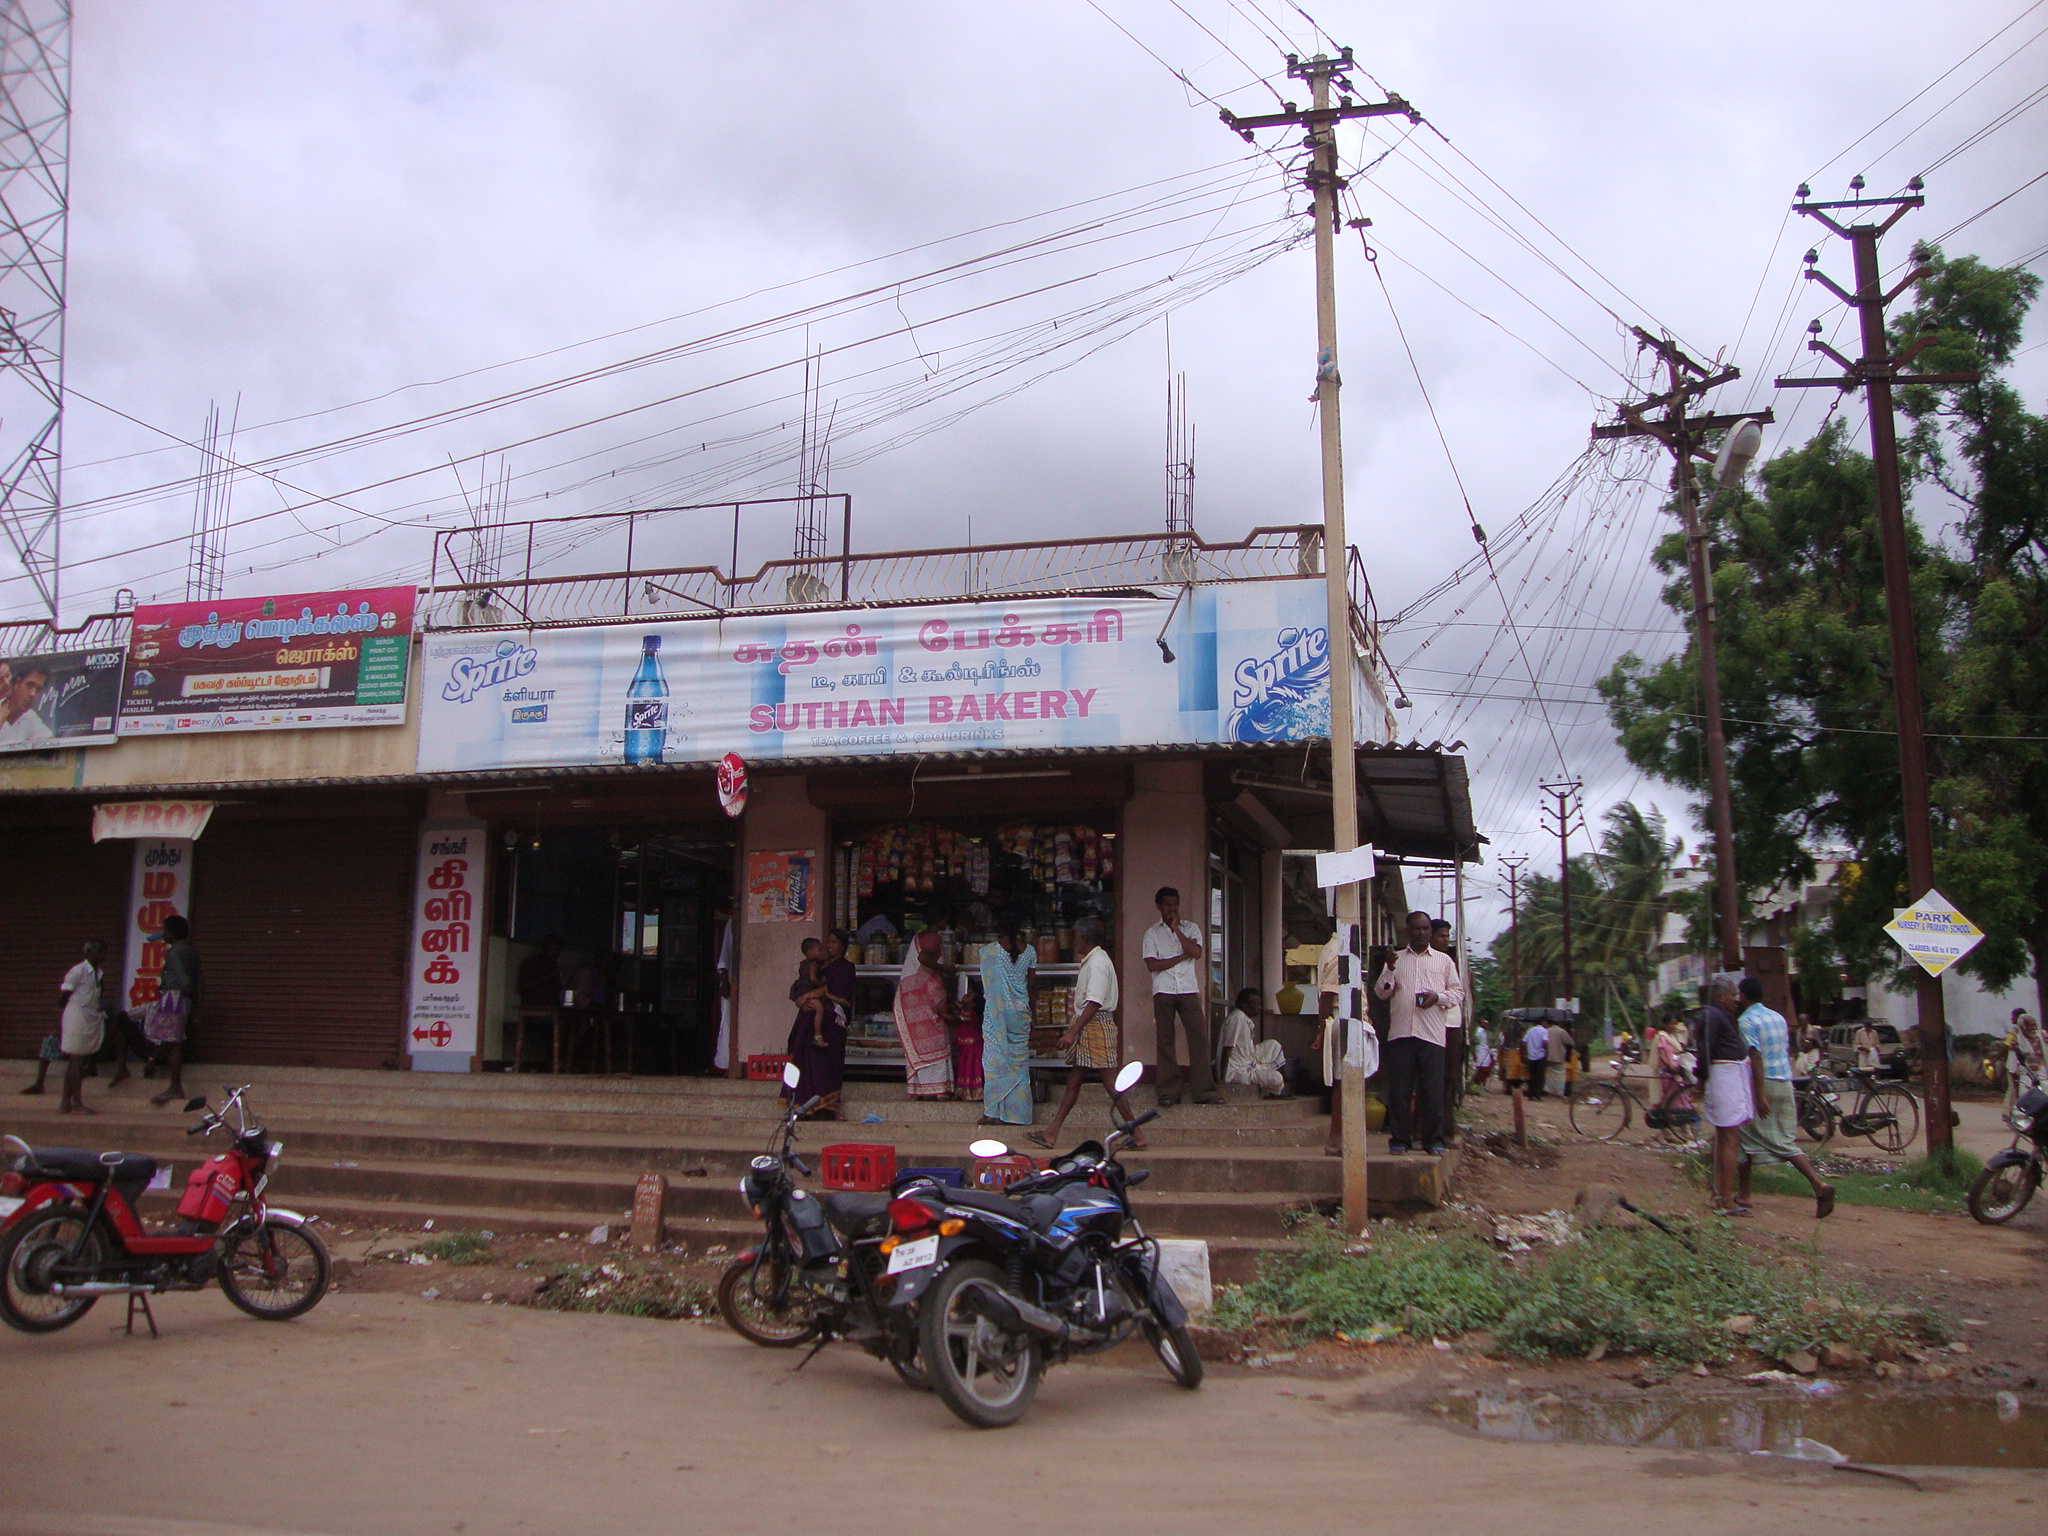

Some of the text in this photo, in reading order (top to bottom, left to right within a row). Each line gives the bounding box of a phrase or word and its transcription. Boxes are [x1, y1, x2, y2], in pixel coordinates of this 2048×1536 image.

[178, 601, 379, 649] முத்து மெடிக்கல்ஸ்
[733, 608, 1123, 675] சுதன் பேக்கரி
[86, 652, 120, 666] MOODS
[276, 640, 358, 665] ஜெராக்ஸ்
[368, 655, 398, 663] SCANNING
[365, 664, 399, 672] LAMINATION
[442, 642, 537, 703] Sprite
[842, 667, 887, 686] காபி
[898, 667, 917, 683] &
[1234, 627, 1329, 708] Sprite
[193, 678, 224, 691] பகவதி
[274, 673, 317, 687] ஜோதிடம்
[358, 690, 401, 698] DOWNLOADING
[121, 706, 155, 714] AVAILABLE
[633, 704, 659, 726] Sprite
[748, 688, 1098, 733] SUTHAN BAKERY
[896, 732, 908, 743] &
[913, 728, 1005, 744] COOLDRINKS
[102, 803, 211, 831] XEROX
[145, 841, 182, 867] முத்து
[789, 870, 804, 914] Horlicks
[1914, 911, 1953, 924] PARK
[1897, 920, 1920, 930] NURSERY
[1926, 923, 1949, 933] PRIMARY
[1950, 924, 1971, 935] SCHOOL
[1931, 946, 1939, 954] KG
[1950, 947, 1960, 955] STD
